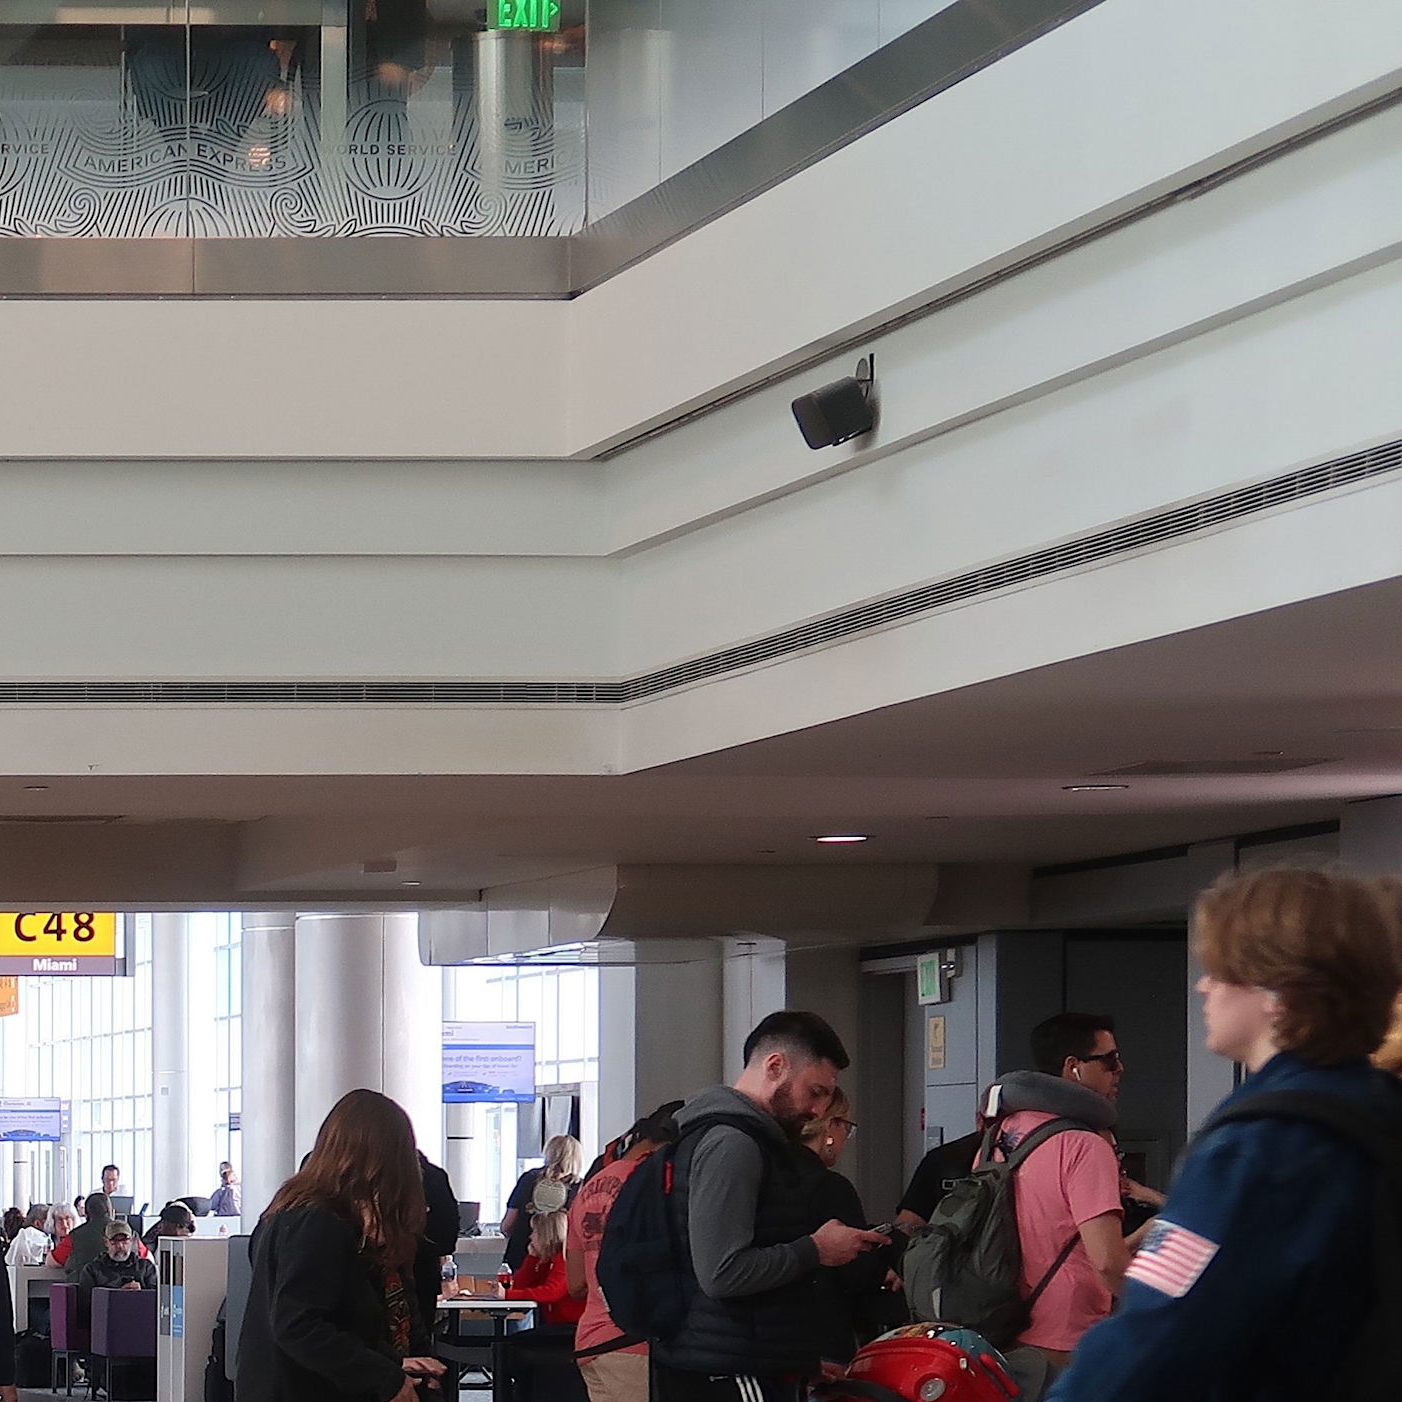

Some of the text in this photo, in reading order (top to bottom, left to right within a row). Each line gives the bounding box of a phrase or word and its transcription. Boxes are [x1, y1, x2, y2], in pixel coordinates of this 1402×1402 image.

[84, 143, 188, 172] AMERICAN
[14, 912, 95, 942] C48
[32, 957, 77, 972] Miami
